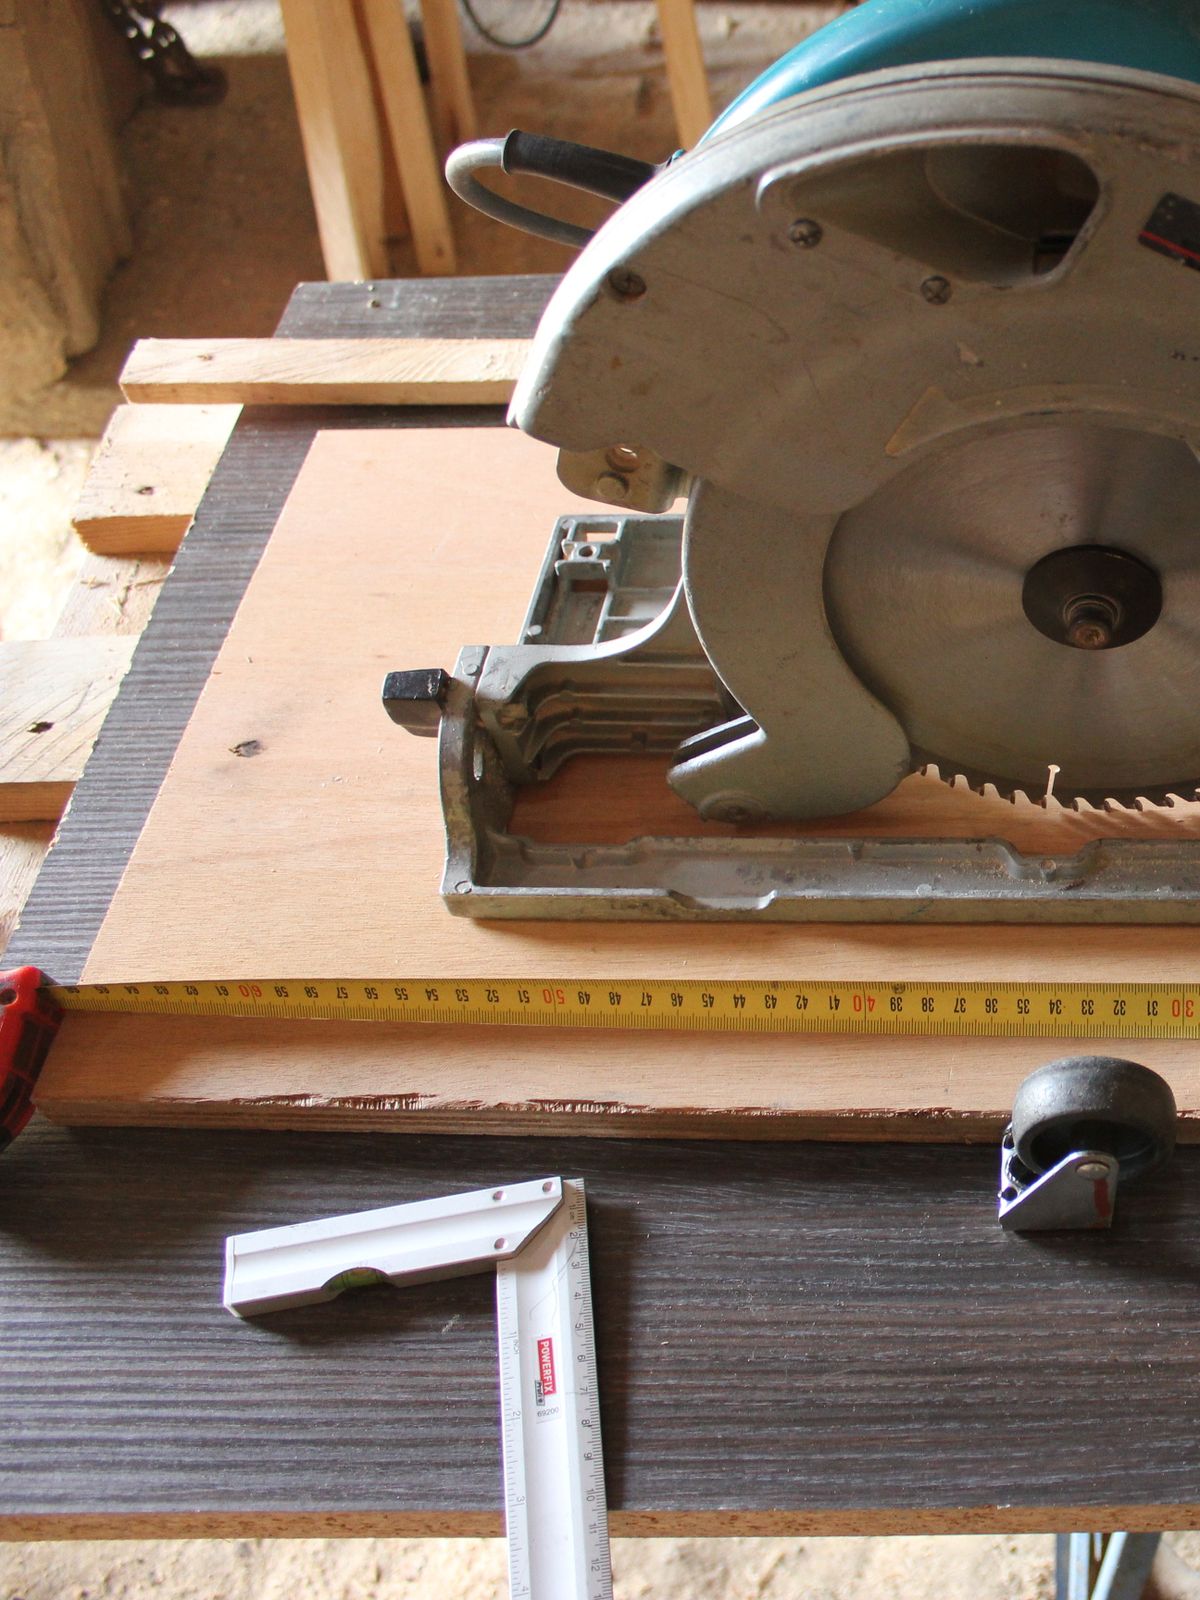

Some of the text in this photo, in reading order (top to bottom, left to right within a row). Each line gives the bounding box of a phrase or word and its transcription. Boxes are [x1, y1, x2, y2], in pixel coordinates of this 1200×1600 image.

[216, 985, 229, 996] 61
[238, 984, 262, 998] 60
[274, 984, 288, 998] 59
[304, 986, 318, 998] 58
[336, 987, 348, 999] 57
[364, 987, 378, 1000] 56
[395, 987, 408, 1000] 55
[425, 988, 438, 1001] 54
[456, 988, 469, 1002] 53
[485, 989, 499, 1003] 52
[517, 990, 530, 1004] 51
[543, 988, 565, 1005] 50
[578, 991, 590, 1005] 49
[609, 991, 621, 1006] 48
[641, 992, 652, 1007] 47
[671, 993, 683, 1007] 46
[702, 993, 714, 1008] 45
[733, 994, 745, 1009] 44
[765, 994, 777, 1009] 43
[796, 995, 808, 1010] 42
[829, 995, 840, 1010] 41
[853, 995, 875, 1012] 40
[891, 997, 902, 1012] 39
[922, 997, 934, 1012] 38
[954, 998, 966, 1013] 37
[986, 998, 998, 1014] 36
[1017, 999, 1029, 1014] 35
[1050, 999, 1062, 1015] 34
[1082, 1000, 1094, 1015] 33
[1114, 1000, 1126, 1016] 32
[1147, 1000, 1158, 1016] 31
[1172, 1000, 1193, 1017] 30
[540, 1340, 554, 1393] POWERFIX
